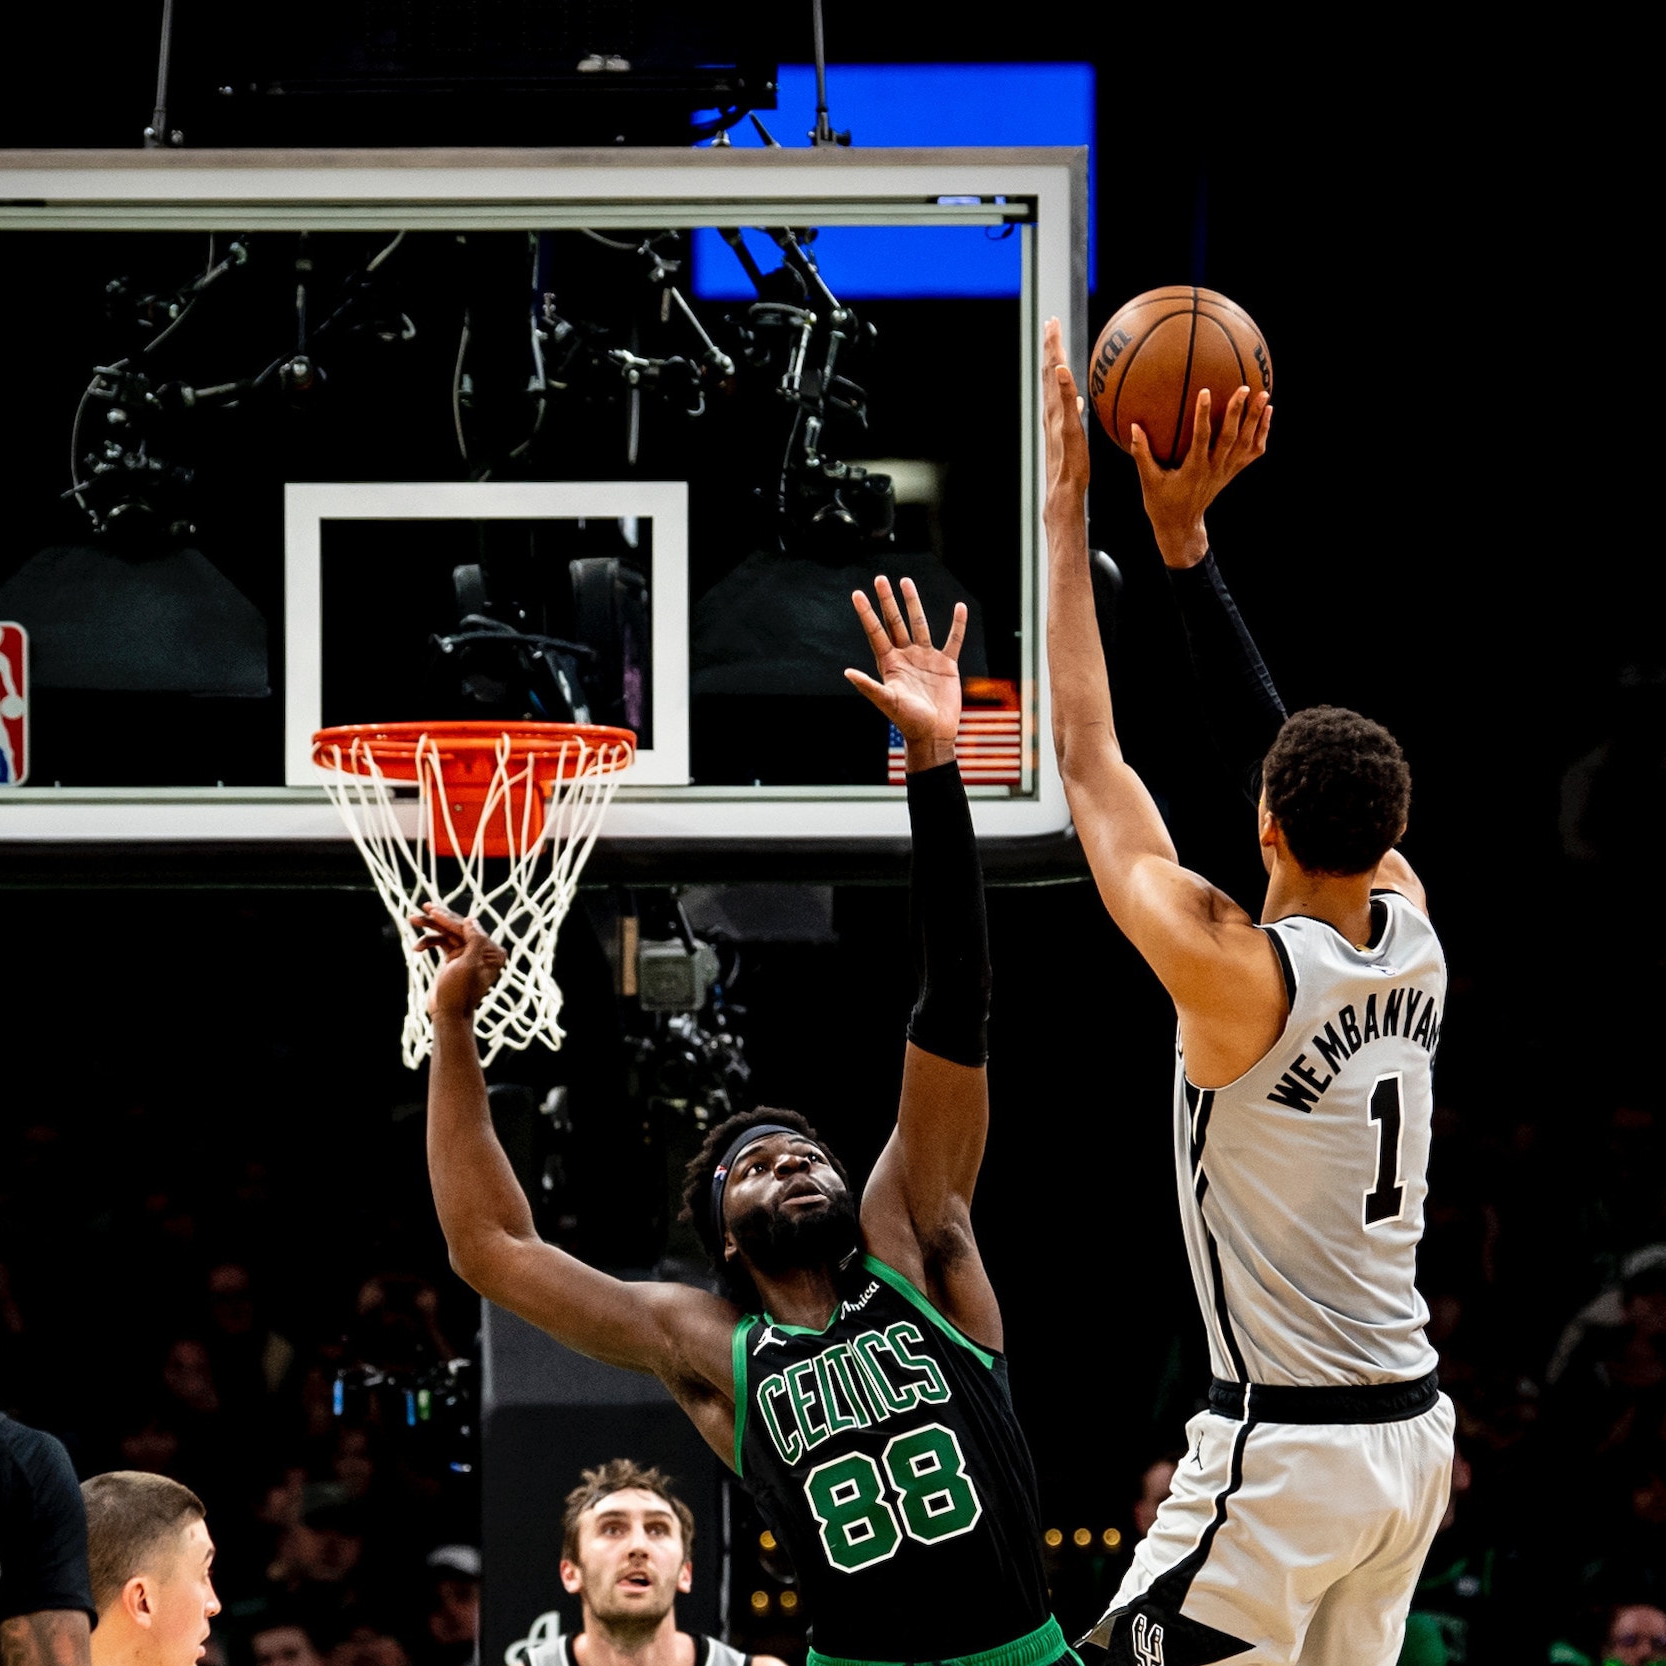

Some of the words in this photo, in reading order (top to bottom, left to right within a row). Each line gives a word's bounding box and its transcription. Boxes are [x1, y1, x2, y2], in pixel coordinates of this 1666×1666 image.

[1362, 1070, 1409, 1232] 1
[839, 1281, 881, 1321] Amica
[756, 1320, 952, 1467] CELTICS
[803, 1422, 984, 1575] 88
